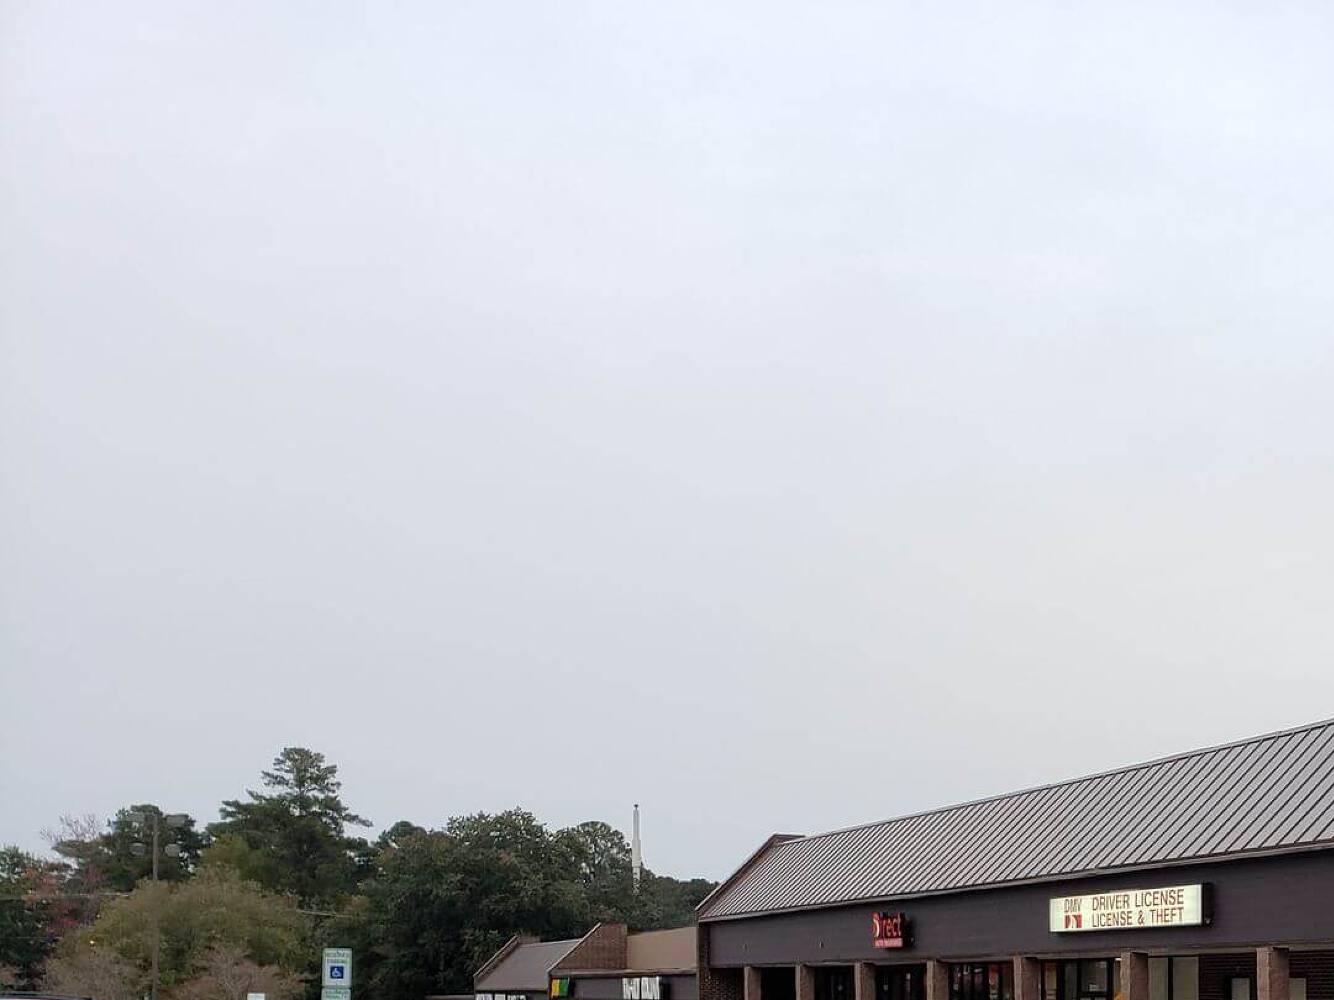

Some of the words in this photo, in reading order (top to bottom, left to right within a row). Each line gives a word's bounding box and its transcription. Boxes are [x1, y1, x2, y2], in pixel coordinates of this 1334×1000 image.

[1064, 898, 1083, 914] DMV
[1092, 894, 1131, 911] DRIVER
[1135, 888, 1185, 908] LICENSE
[1092, 910, 1133, 928] LICENSE
[1137, 911, 1145, 926] &
[1150, 906, 1184, 924] THEFT
